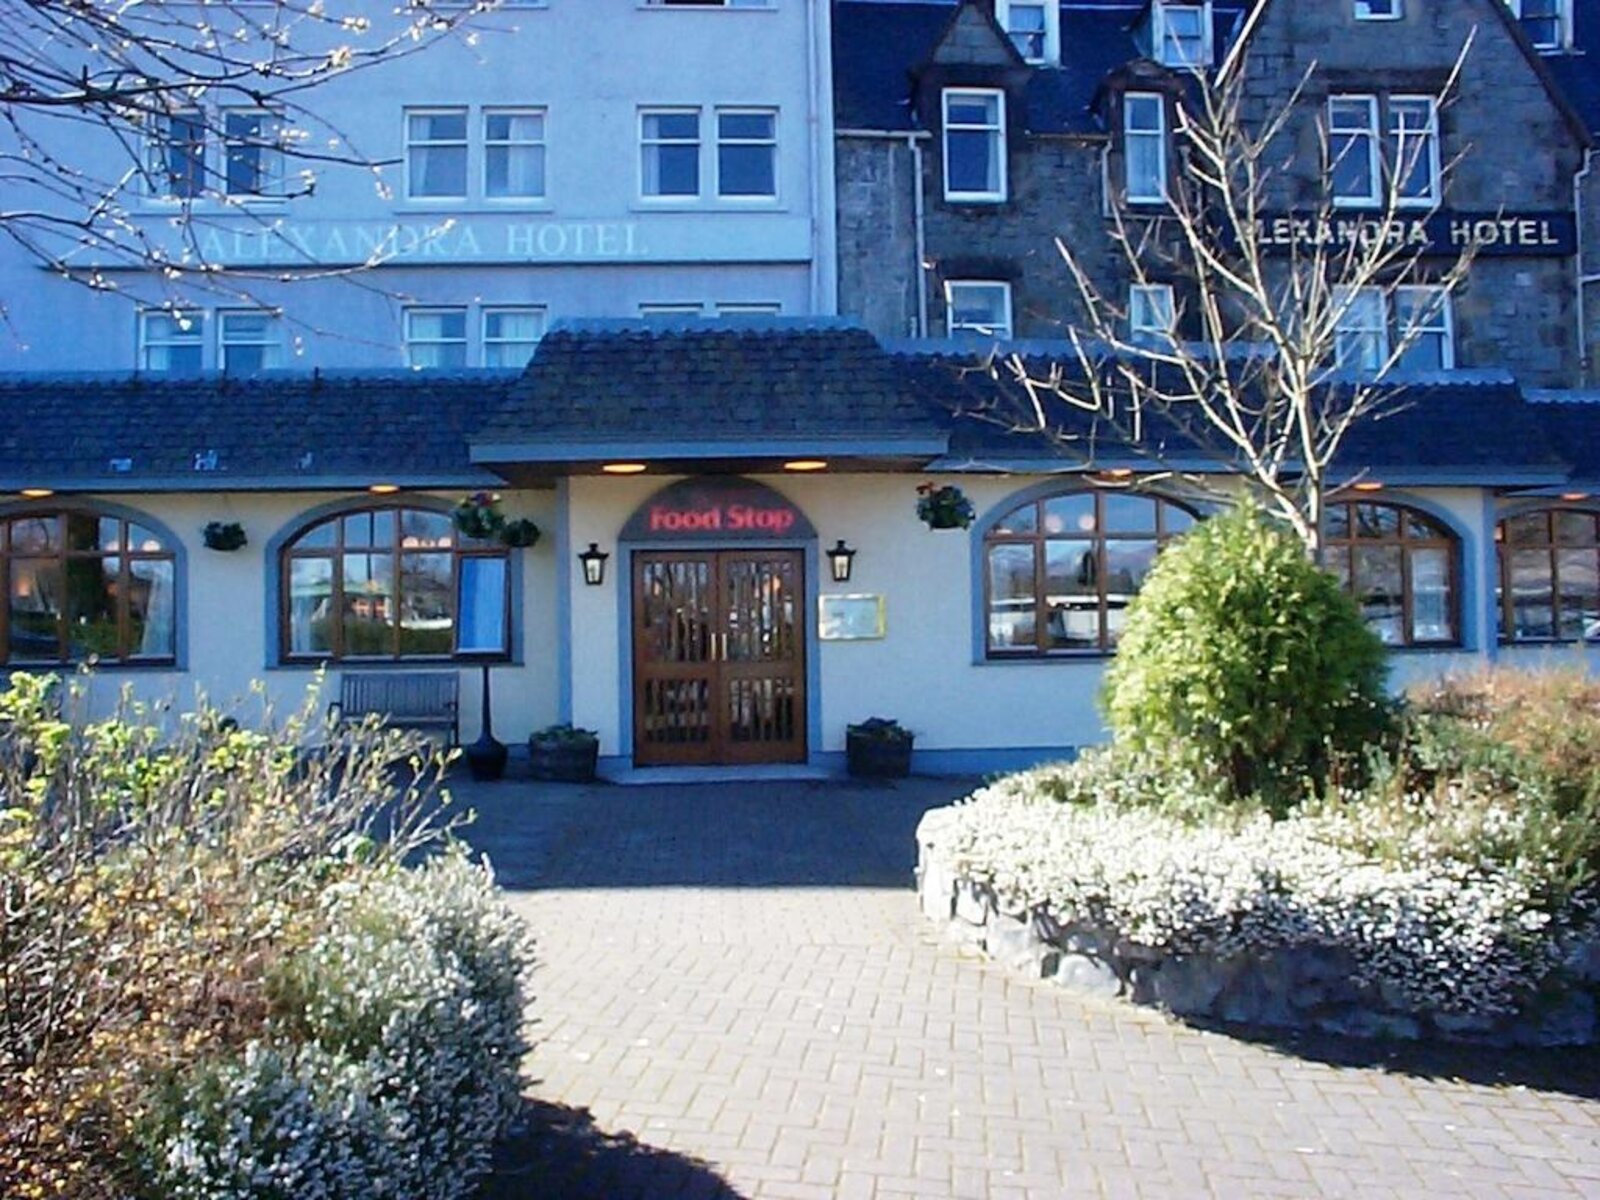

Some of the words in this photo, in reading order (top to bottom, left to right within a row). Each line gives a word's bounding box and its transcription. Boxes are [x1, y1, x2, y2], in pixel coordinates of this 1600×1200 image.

[202, 222, 482, 258] ALEXANDRA
[506, 223, 649, 256] HOTEL
[1449, 219, 1560, 246] HOTEL
[649, 505, 721, 531] Food
[726, 504, 794, 535] Stop
